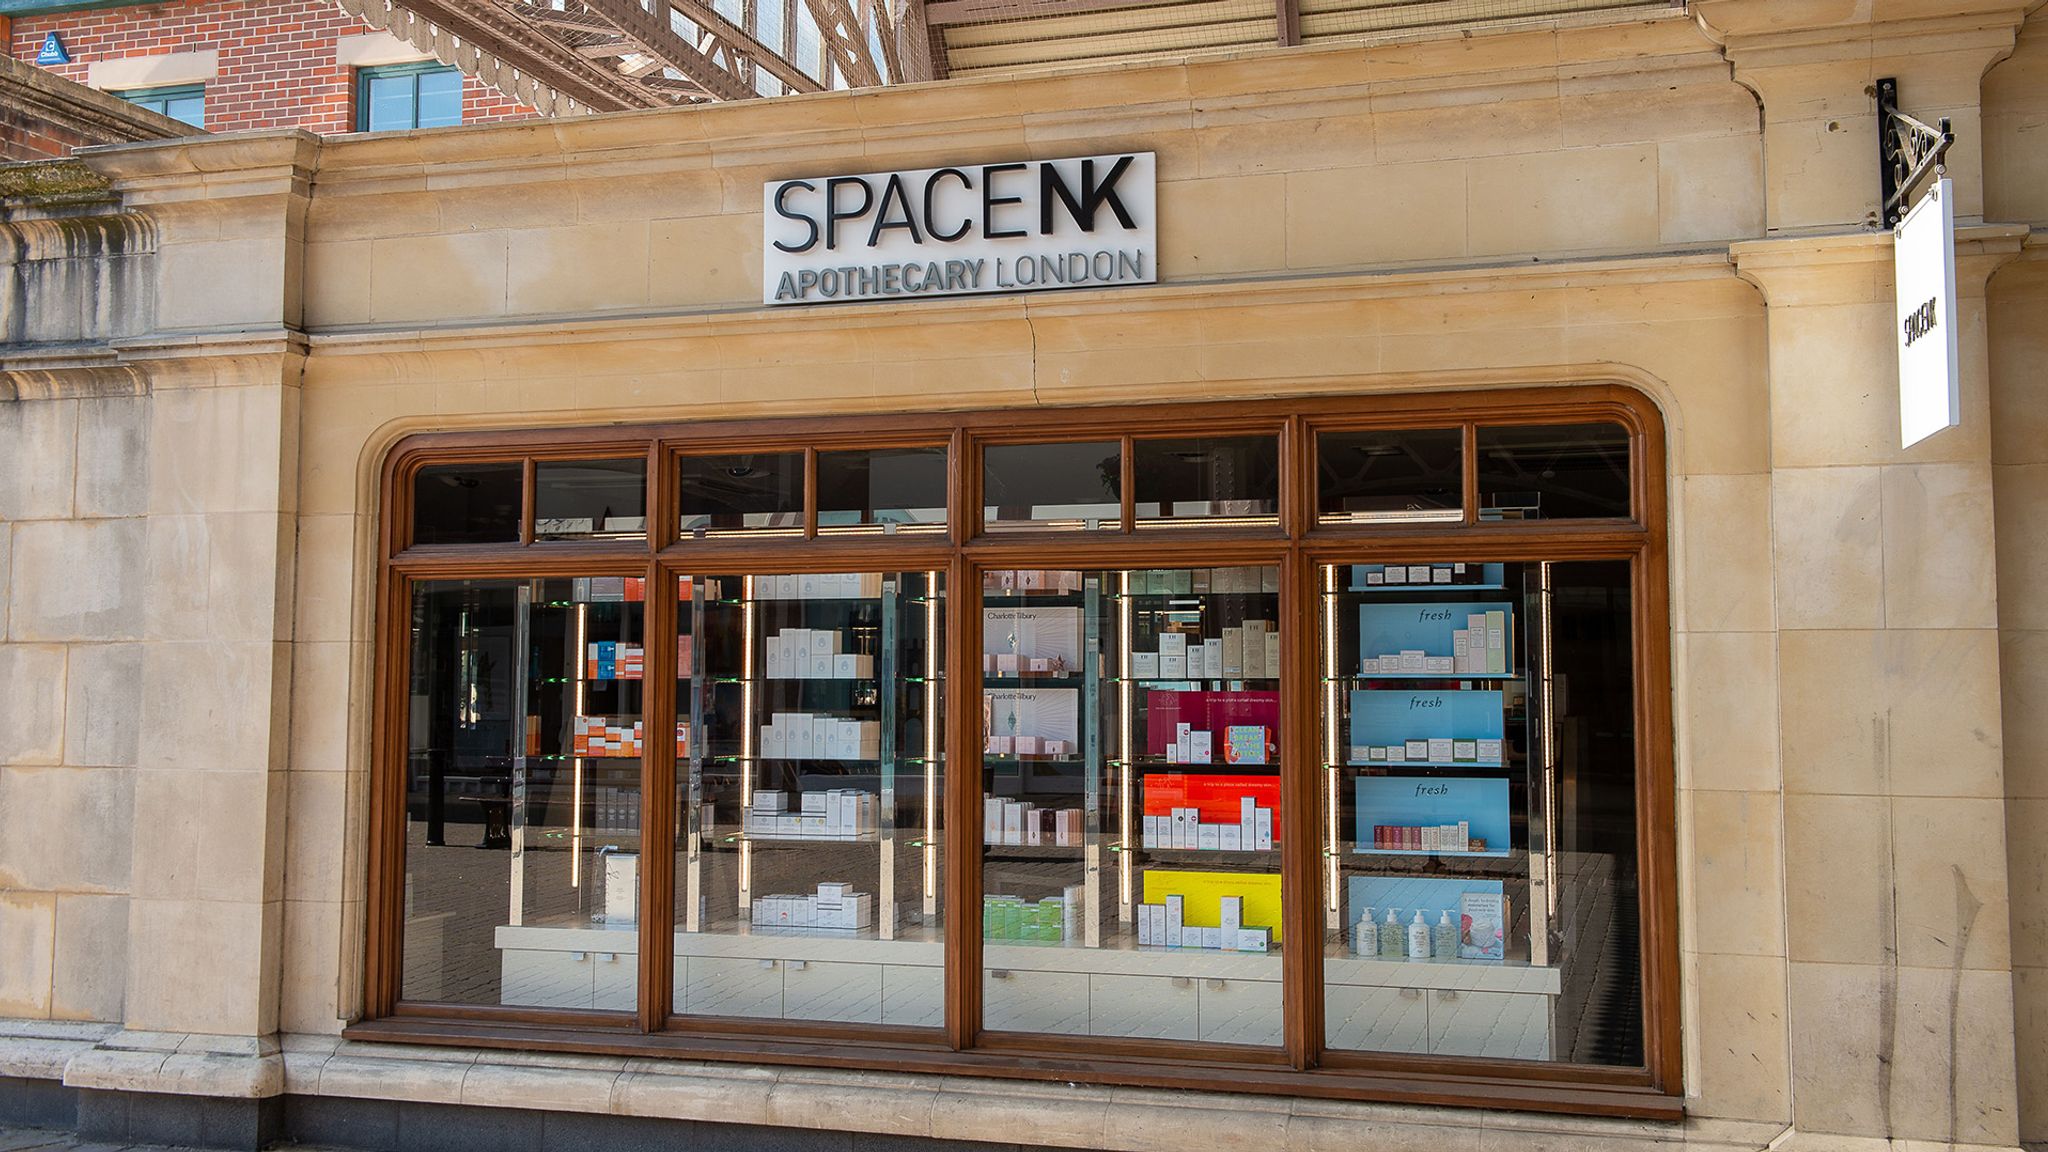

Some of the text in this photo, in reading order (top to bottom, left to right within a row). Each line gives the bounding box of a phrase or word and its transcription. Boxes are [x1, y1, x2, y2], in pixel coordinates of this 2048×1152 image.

[775, 249, 1142, 300] APOTHECARY LONDON
[1419, 609, 1451, 623] fresh
[1410, 695, 1442, 710] fresh
[1415, 784, 1448, 797] fresh
